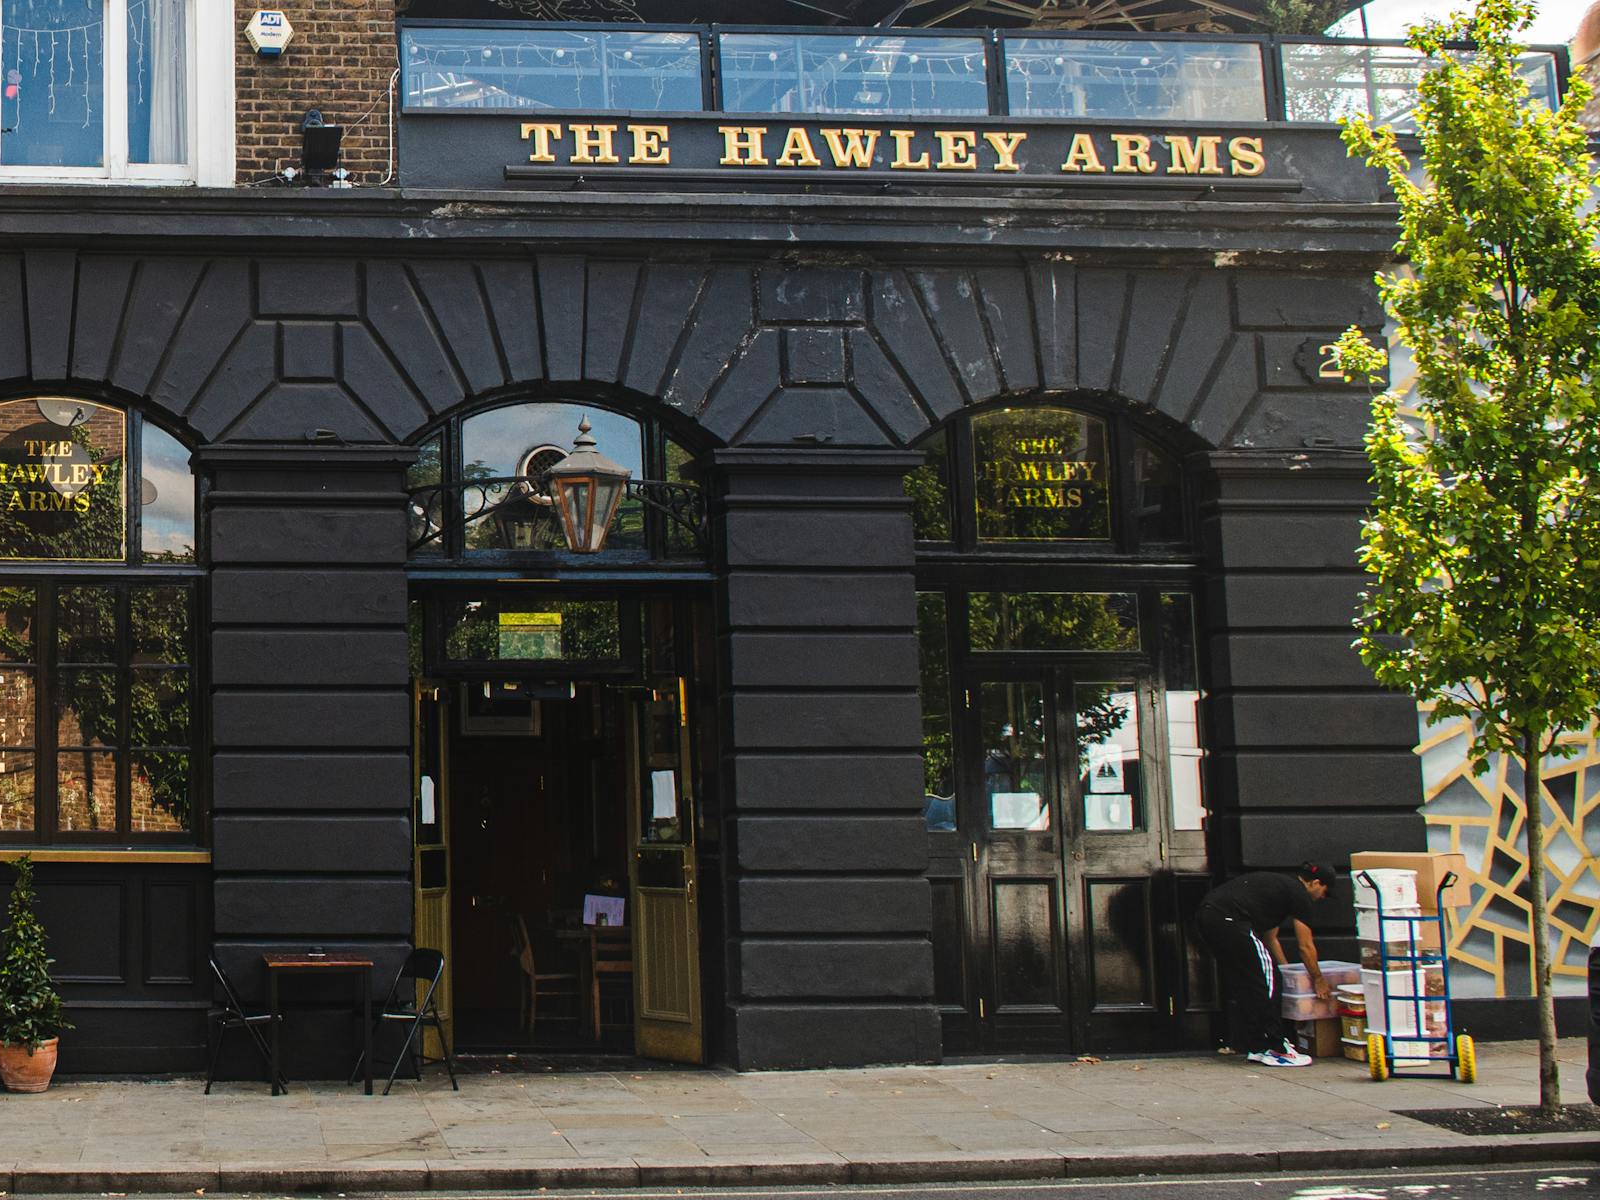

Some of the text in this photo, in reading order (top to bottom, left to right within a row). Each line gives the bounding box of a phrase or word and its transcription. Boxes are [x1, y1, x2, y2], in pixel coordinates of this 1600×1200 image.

[261, 14, 281, 25] ADT
[521, 123, 1266, 177] THE HAWLEY ARMS
[24, 440, 73, 457] THE
[1016, 438, 1063, 454] THE
[982, 461, 1097, 481] HAWLEY
[7, 490, 90, 513] ARMS
[1007, 487, 1083, 507] ARMS
